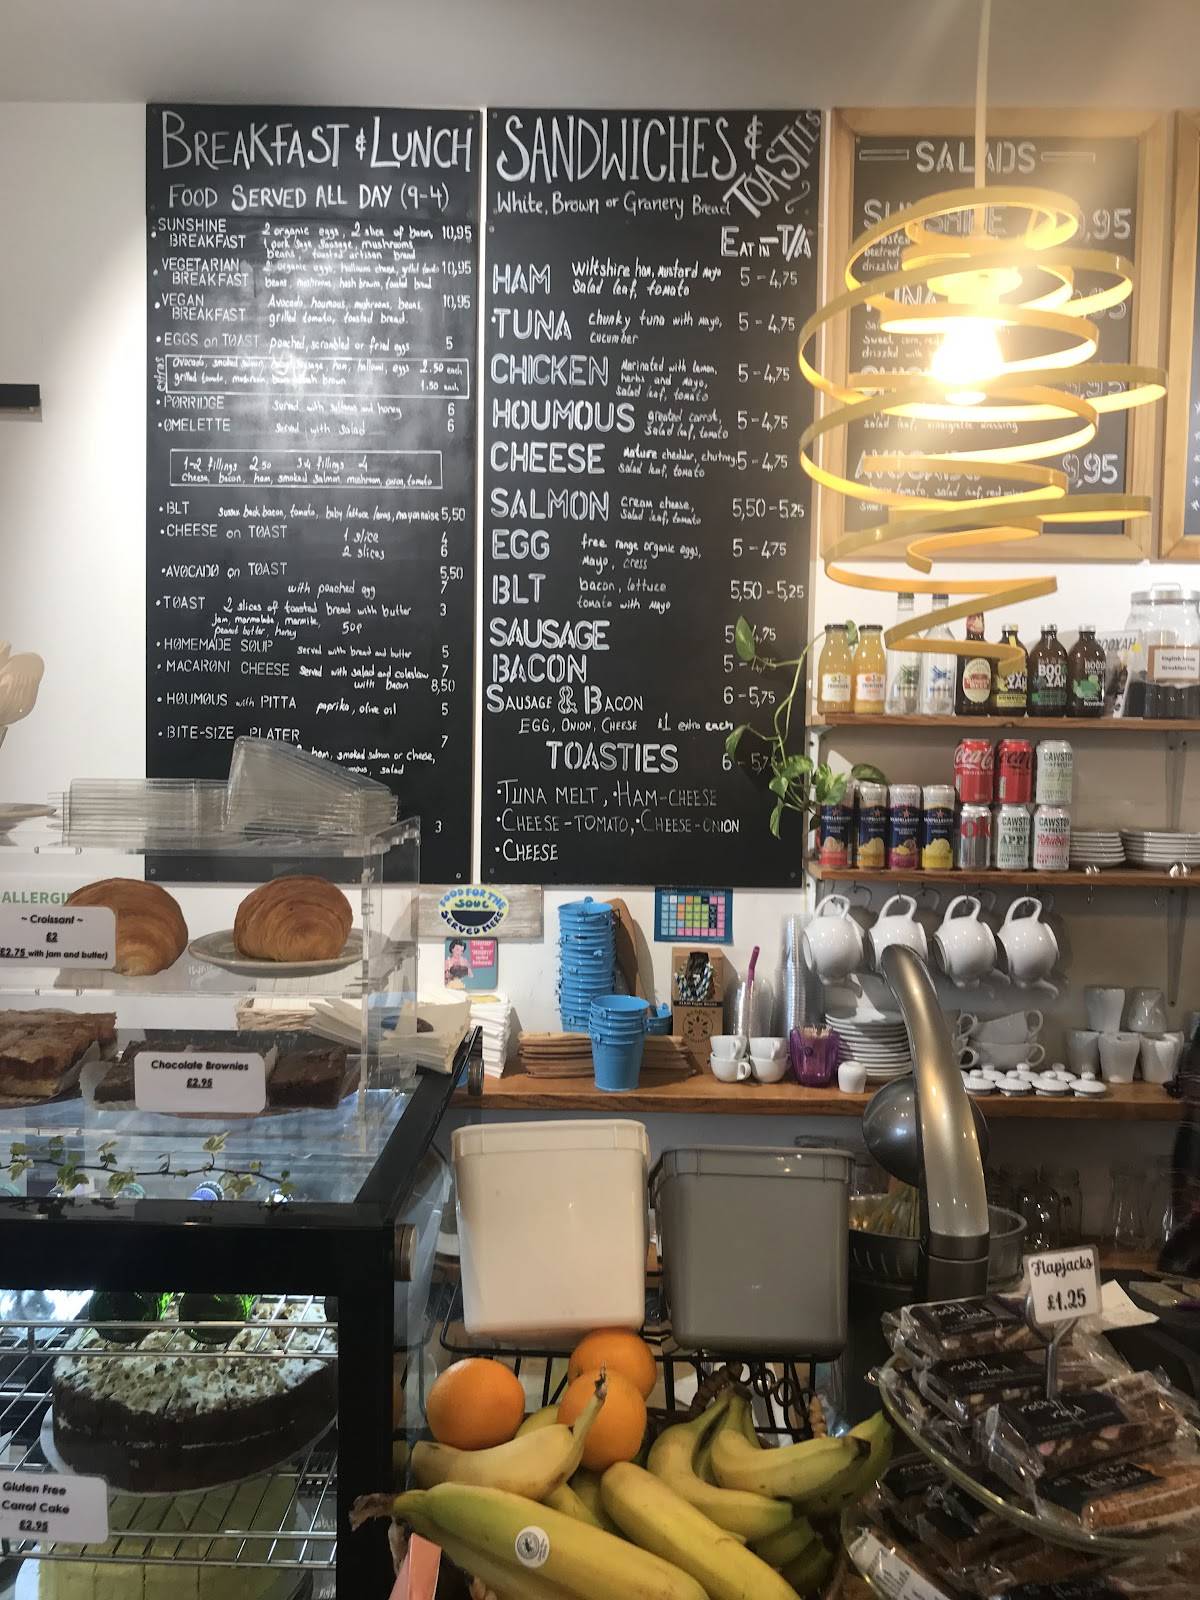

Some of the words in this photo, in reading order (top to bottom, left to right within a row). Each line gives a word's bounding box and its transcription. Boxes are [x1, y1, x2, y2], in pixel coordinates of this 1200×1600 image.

[161, 110, 350, 171] BREAKFAST
[355, 127, 366, 160] &
[370, 116, 472, 172] LUNCH
[496, 114, 736, 184] SANDWICHES
[744, 115, 763, 160] &
[722, 110, 821, 219] TOASTIES
[168, 183, 217, 208] FOOD
[232, 184, 306, 211] SERVED
[316, 185, 347, 205] ALL
[359, 184, 392, 208] DAY
[401, 182, 449, 212] (9-4)
[552, 193, 599, 215] Brown
[606, 196, 619, 208] or
[158, 218, 226, 233] SUNSHINE
[442, 225, 472, 243] 10,95
[169, 235, 246, 249] BREAKFAST
[161, 258, 240, 271] VEGETARIAN
[441, 261, 471, 279] 10,95
[173, 272, 249, 287] BREAKFAST
[493, 263, 551, 294] HAM
[161, 294, 203, 307] VEGAN
[442, 295, 471, 310] 10,95
[172, 307, 246, 321] BREAKFAST
[494, 308, 571, 341] TUNA
[165, 333, 199, 346] EGGS
[204, 338, 217, 347] on
[222, 334, 259, 347] TOAST
[446, 336, 453, 351] 5
[490, 353, 609, 386] CHICKEN
[164, 396, 225, 410] PORRIDGE
[448, 402, 455, 416] 6
[493, 398, 635, 433] HOUMOUS
[164, 418, 231, 432] OMELETTE
[448, 419, 455, 433] 6
[490, 441, 606, 474] CHEESE
[166, 501, 190, 515] BLT
[441, 506, 465, 523] 5,50
[490, 488, 609, 521] SALMON
[166, 524, 217, 538] CHEESE
[226, 529, 241, 539] on
[248, 525, 287, 539] TOAST
[353, 528, 379, 543] slice
[440, 532, 448, 545] 4
[492, 529, 549, 560] EGG
[581, 532, 606, 549] free
[616, 539, 638, 554] range
[356, 547, 385, 560] slices
[440, 546, 448, 558] 6
[166, 565, 218, 578] AVOCADO
[227, 567, 240, 579] on
[248, 563, 287, 576] TOAST
[440, 566, 463, 581] 5,50
[492, 573, 546, 604] BLT
[163, 596, 206, 610] TOAST
[237, 598, 262, 613] slices
[267, 600, 278, 615] of
[357, 602, 377, 616] with
[440, 604, 447, 616] 3
[490, 617, 610, 650] SAUSAGE
[164, 638, 232, 652] HOMEMADE
[240, 640, 273, 653] SOUP
[297, 644, 321, 656] served
[328, 647, 346, 656] with
[375, 648, 386, 657] and
[441, 645, 449, 658] 5
[166, 660, 230, 673] MACARONI
[241, 662, 290, 676] CHEESE
[331, 665, 347, 677] with
[351, 665, 374, 679] salad
[378, 666, 391, 678] and
[441, 664, 448, 678] 7
[493, 653, 587, 684] BACON
[166, 693, 228, 706] HOUMOUS
[235, 697, 254, 707] with
[260, 696, 297, 708] PITTA
[384, 702, 396, 715] oil
[441, 703, 448, 715] 5
[487, 684, 553, 714] SAUSAGE
[558, 686, 578, 715] &
[584, 686, 644, 714] BACON
[601, 717, 638, 734] CHEESE
[705, 721, 734, 732] each
[167, 726, 234, 739] BITE-SIZE
[440, 735, 448, 749] 7
[546, 740, 678, 774] TOASTIES
[502, 779, 547, 805] TUNA
[502, 838, 559, 862] CHEESE
[2, 892, 70, 904] ALLERGI
[440, 888, 464, 907] FOOD
[466, 888, 486, 897] FOR
[488, 892, 507, 910] THE
[455, 899, 489, 909] SOUL
[30, 915, 74, 924] Croissant
[441, 911, 480, 935] SERVED
[482, 911, 504, 932] HERE
[46, 932, 58, 942] £2
[82, 951, 108, 960] butter)
[151, 1060, 202, 1071] Chocolate
[205, 1061, 249, 1072] Brownies
[186, 1078, 213, 1089] £2.95
[1031, 1254, 1093, 1278] Flapjacks
[1047, 1287, 1087, 1312] £1.25
[3, 1481, 39, 1493] Gluten
[43, 1484, 66, 1495] Free
[2, 1500, 36, 1512] Carrot
[40, 1503, 69, 1514] Cake
[19, 1519, 48, 1533] £2.95
